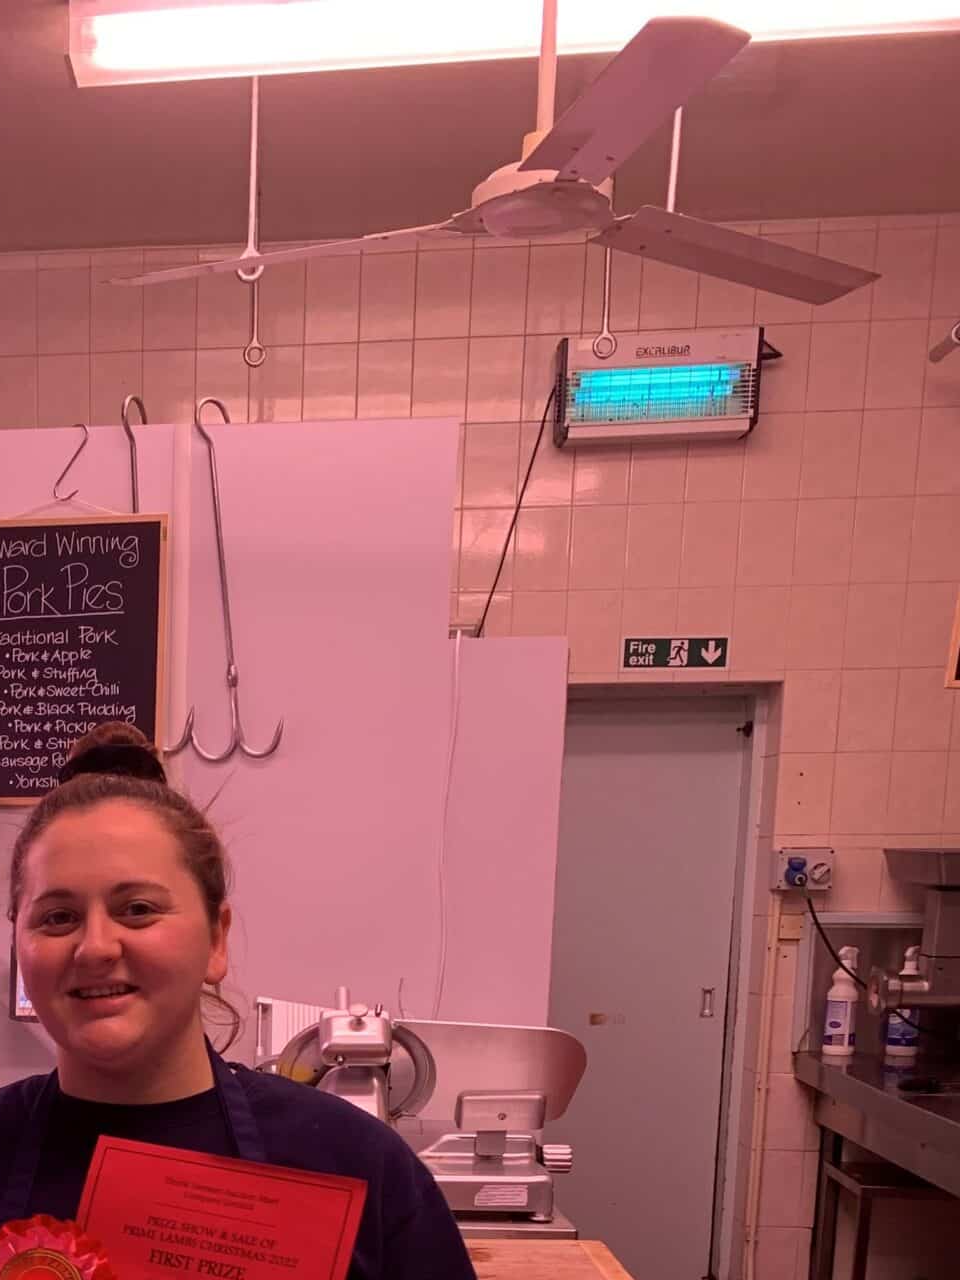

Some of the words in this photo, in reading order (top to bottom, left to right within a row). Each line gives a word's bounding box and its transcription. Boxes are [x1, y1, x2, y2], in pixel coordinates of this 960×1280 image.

[635, 344, 691, 359] EXCALIBUR
[55, 530, 140, 569] Winning
[3, 564, 62, 616] Pork
[60, 562, 124, 611] Pies
[78, 625, 119, 646] Pork
[12, 647, 39, 663] Pork
[50, 646, 92, 665] Apple
[629, 641, 657, 654] Fire
[628, 654, 654, 666] exit
[42, 666, 97, 689] Stuffing
[10, 683, 38, 699] Pork
[46, 684, 86, 697] Sweet
[91, 681, 120, 697] Chilli
[35, 702, 76, 716] Black
[78, 702, 137, 724] Pudding
[14, 719, 43, 733] Pork
[54, 719, 97, 734] Pickle
[16, 773, 60, 789] Yorkshi
[230, 1229, 258, 1246] SALE
[259, 1236, 279, 1250] OF
[149, 1247, 194, 1273] FIRST
[199, 1238, 266, 1263] CHRISTMAS
